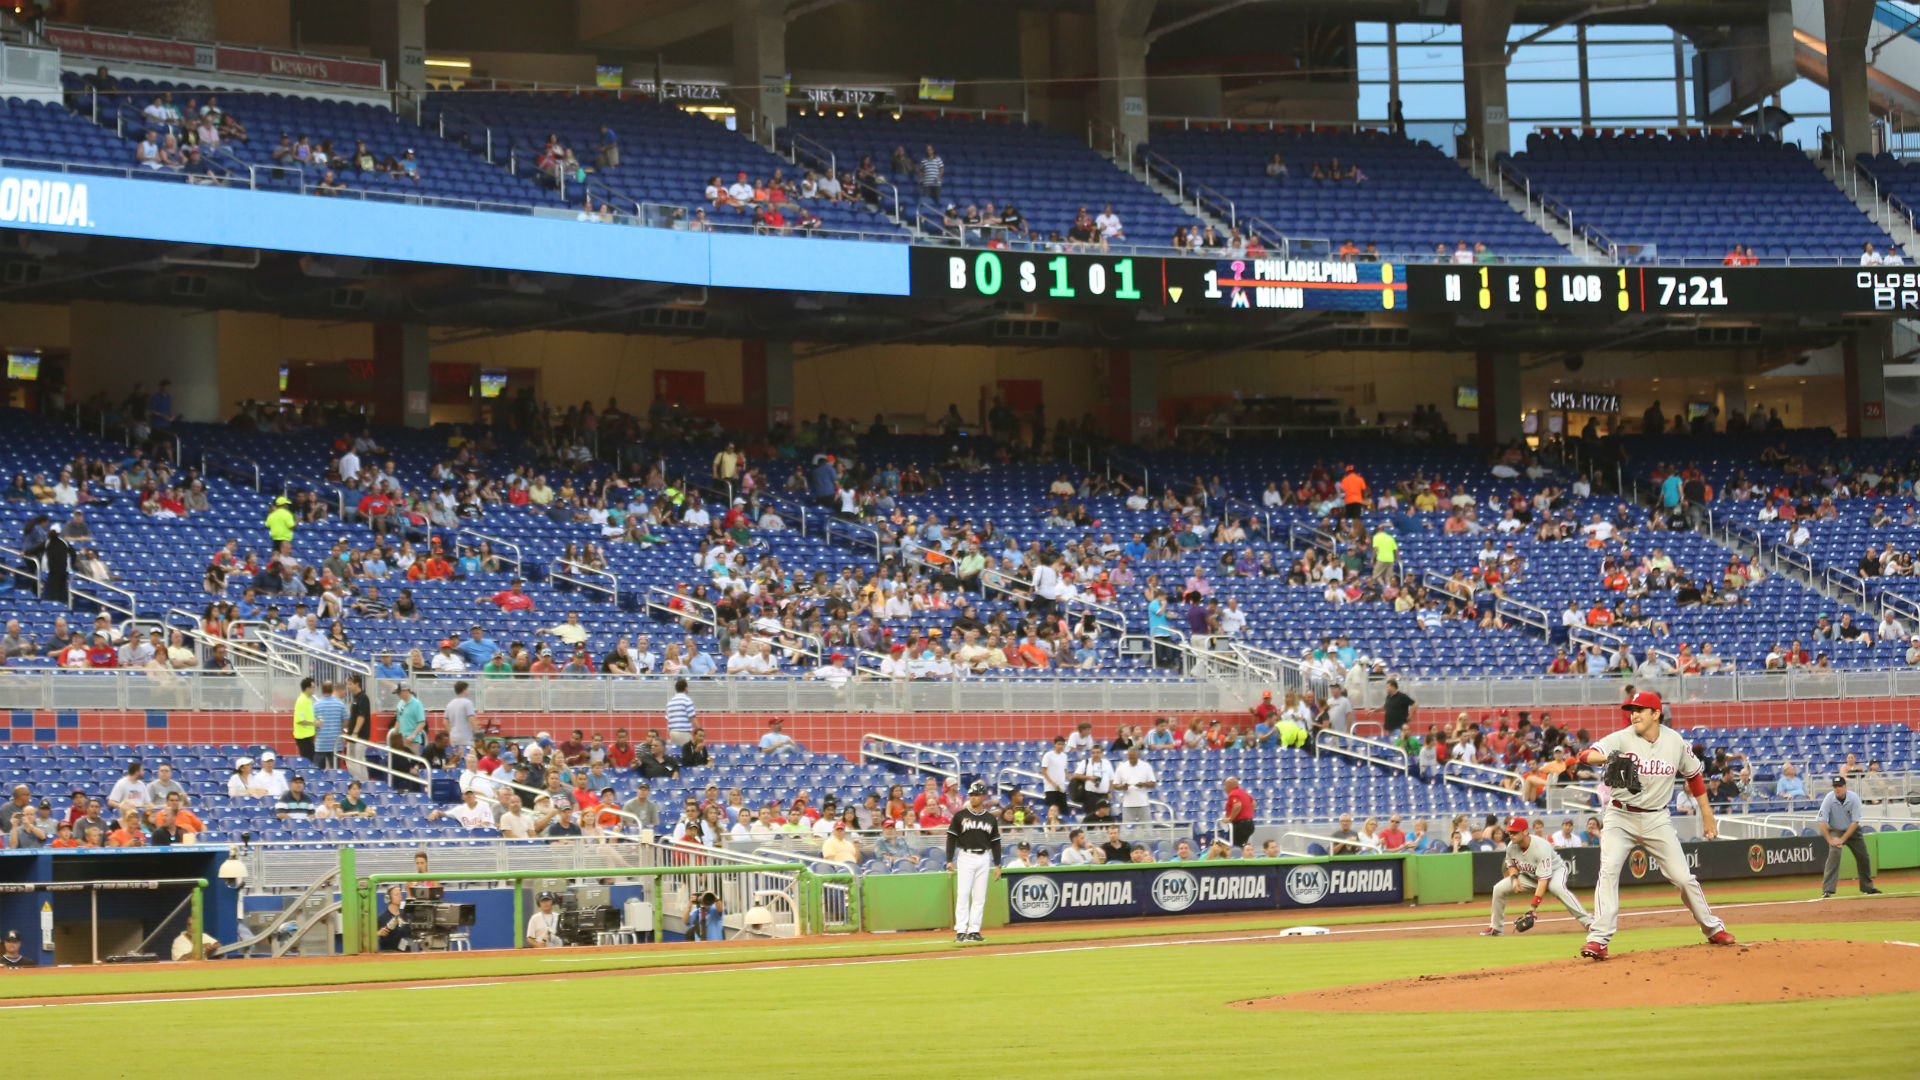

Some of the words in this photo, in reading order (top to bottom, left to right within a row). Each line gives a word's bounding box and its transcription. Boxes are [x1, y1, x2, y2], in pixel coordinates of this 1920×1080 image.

[271, 56, 328, 78] Dewar's
[949, 257, 966, 289] B
[974, 252, 1002, 295] 0
[1019, 261, 1037, 293] S
[1048, 256, 1075, 297] 1
[1114, 258, 1141, 299] 1
[1254, 259, 1358, 283] PHILADELPHIA
[1381, 263, 1394, 284] 0
[1857, 272, 1920, 288] CLOS
[1204, 269, 1223, 298] 1
[1445, 274, 1461, 302] H
[1478, 267, 1489, 288] 1
[1508, 275, 1521, 302] E
[1534, 267, 1547, 288] 0
[1562, 274, 1602, 302] LOB
[1617, 268, 1626, 289] 1
[1657, 276, 1729, 306] 7:21
[1256, 287, 1304, 309] MIAMI
[1382, 288, 1395, 310] 0
[1479, 288, 1491, 310] 0
[1535, 289, 1548, 311] 0
[1617, 290, 1630, 312] 0
[1625, 752, 1675, 776] Phillies
[1766, 843, 1814, 865] BACARDÍ
[1162, 878, 1188, 895] FOX
[1199, 875, 1267, 901] FLORIDA
[1295, 871, 1319, 888] FOX
[1329, 869, 1394, 894] FLORIDA
[1022, 884, 1049, 901] FOX
[1060, 881, 1133, 908] FLORIDA
[1162, 894, 1189, 903] SPORTS
[1295, 888, 1321, 896] SPORTS
[1022, 901, 1050, 909] SPORTS
